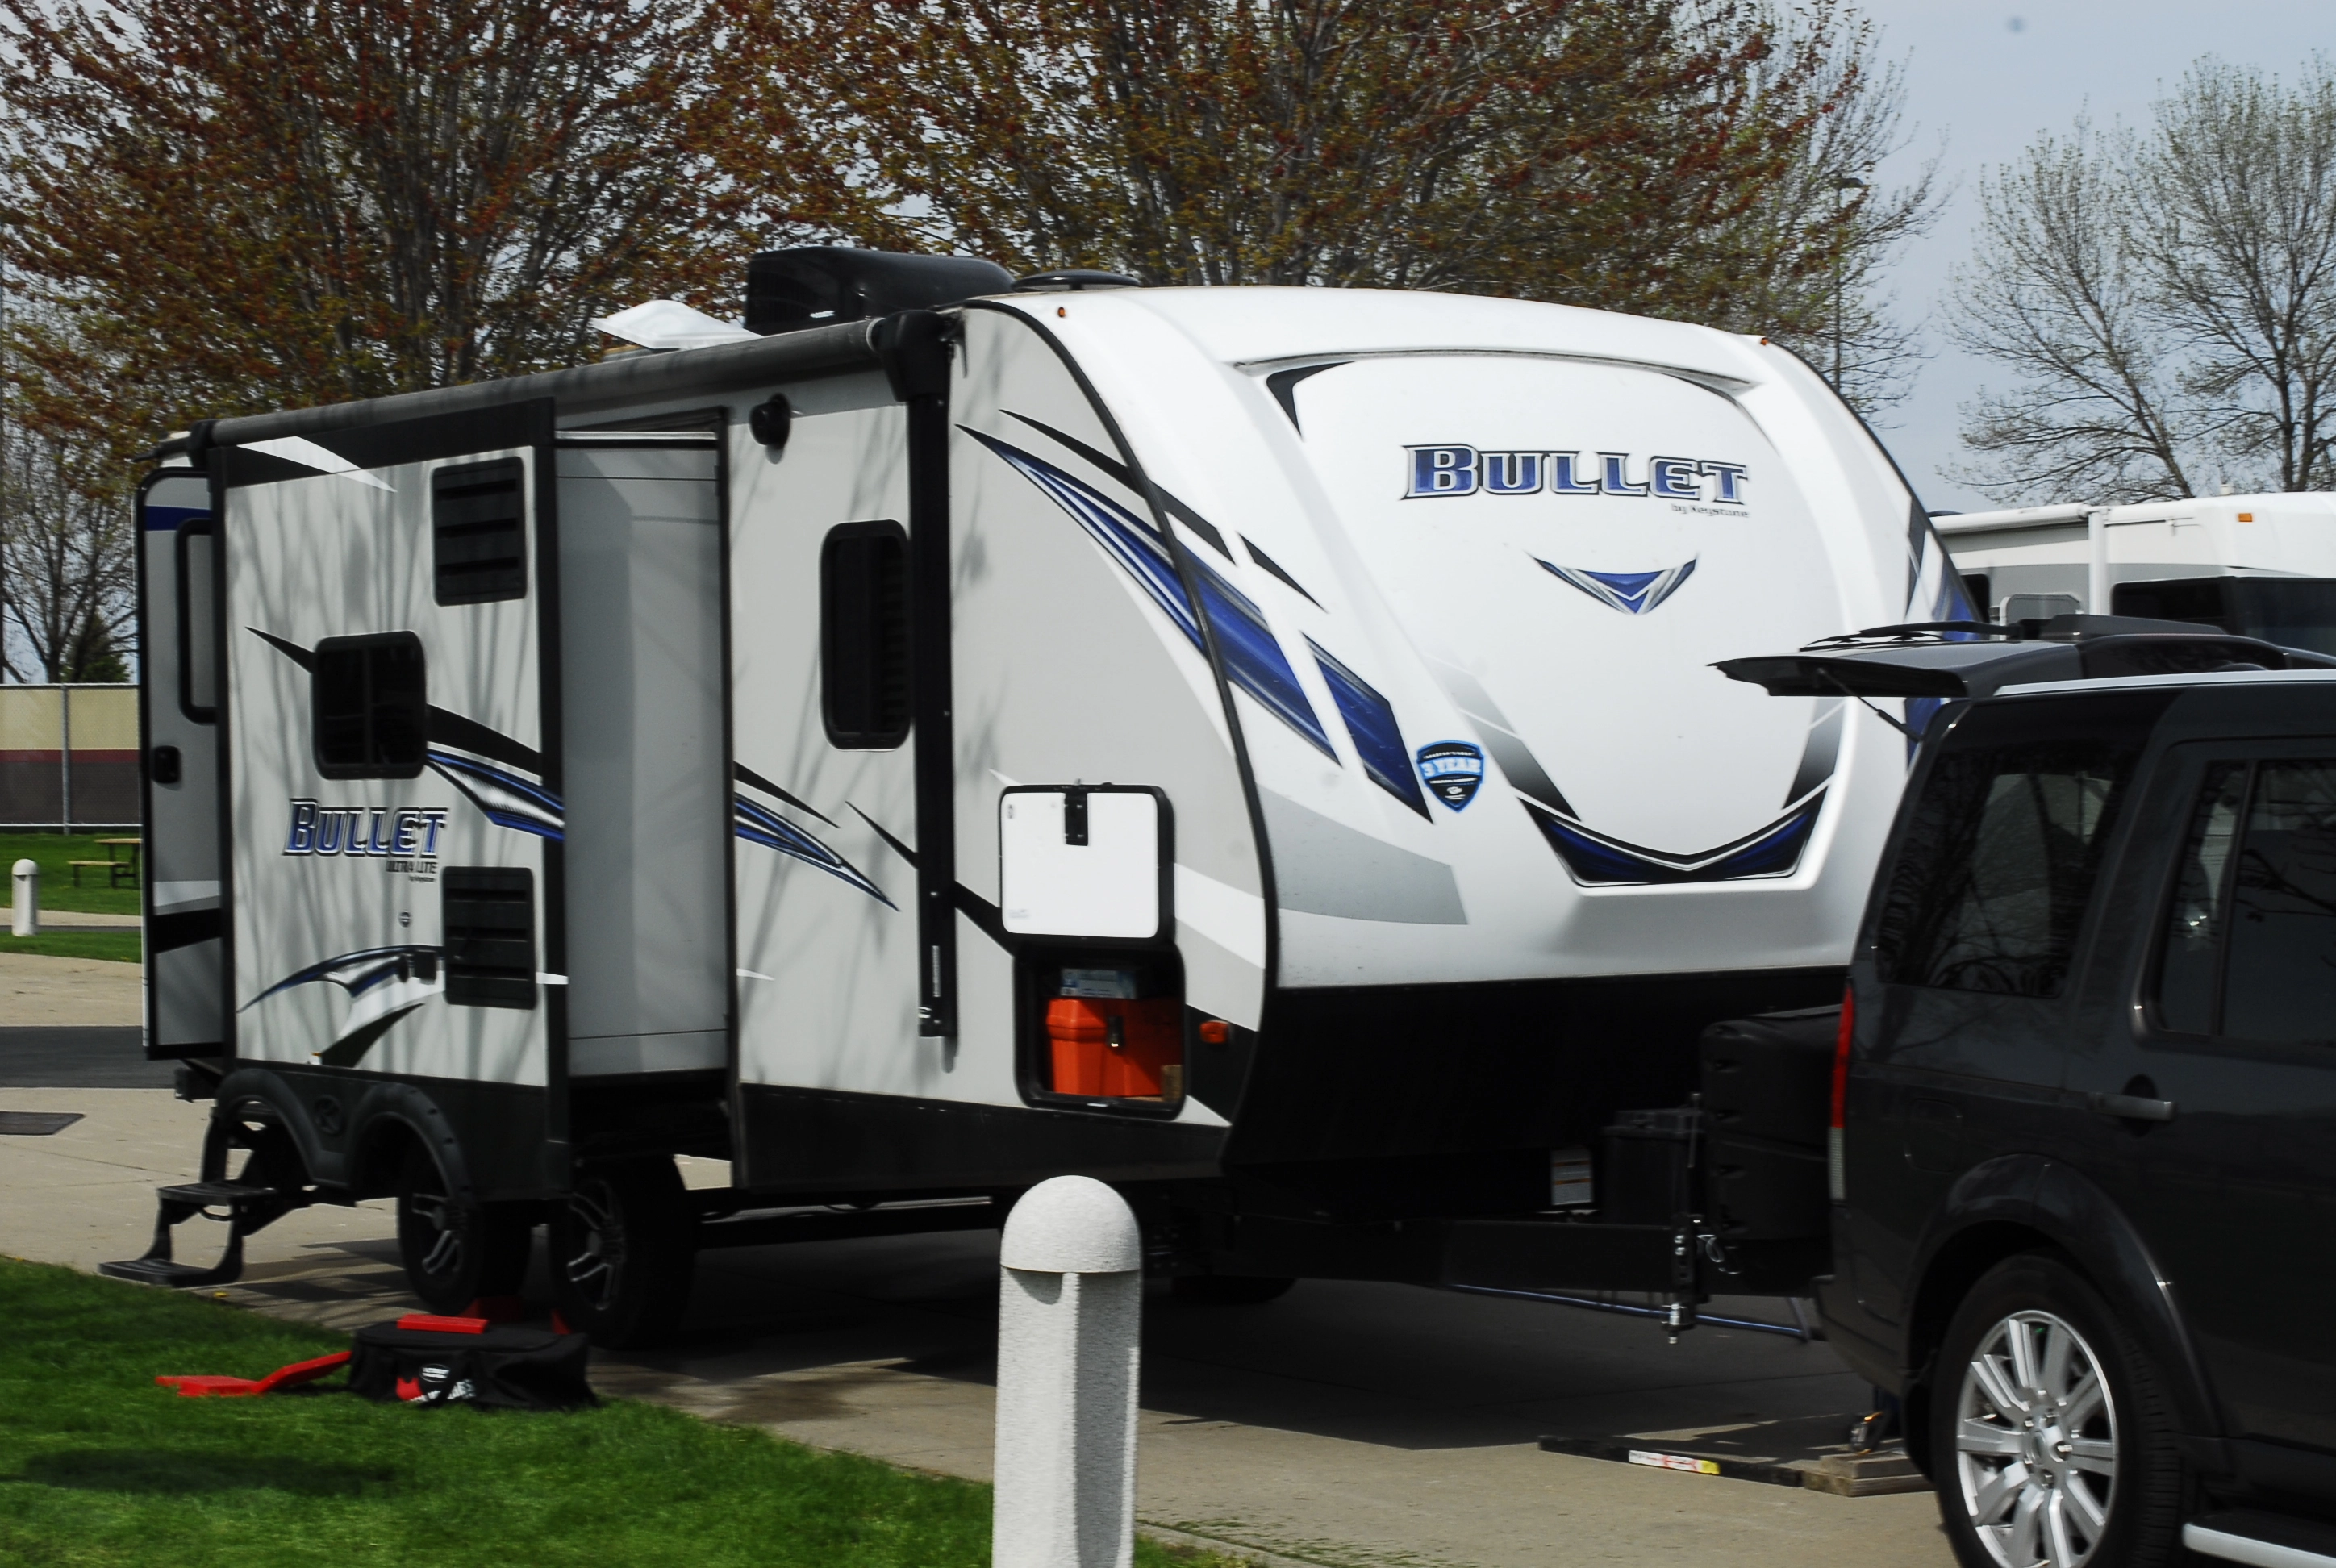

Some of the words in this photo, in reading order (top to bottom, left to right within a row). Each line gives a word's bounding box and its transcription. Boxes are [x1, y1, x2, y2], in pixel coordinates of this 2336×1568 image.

[1400, 443, 1749, 506] BULLET
[1691, 505, 1750, 517] Keystone
[1420, 762, 1435, 777] 3
[1433, 758, 1481, 773] YEAR
[282, 798, 448, 857] BULLET
